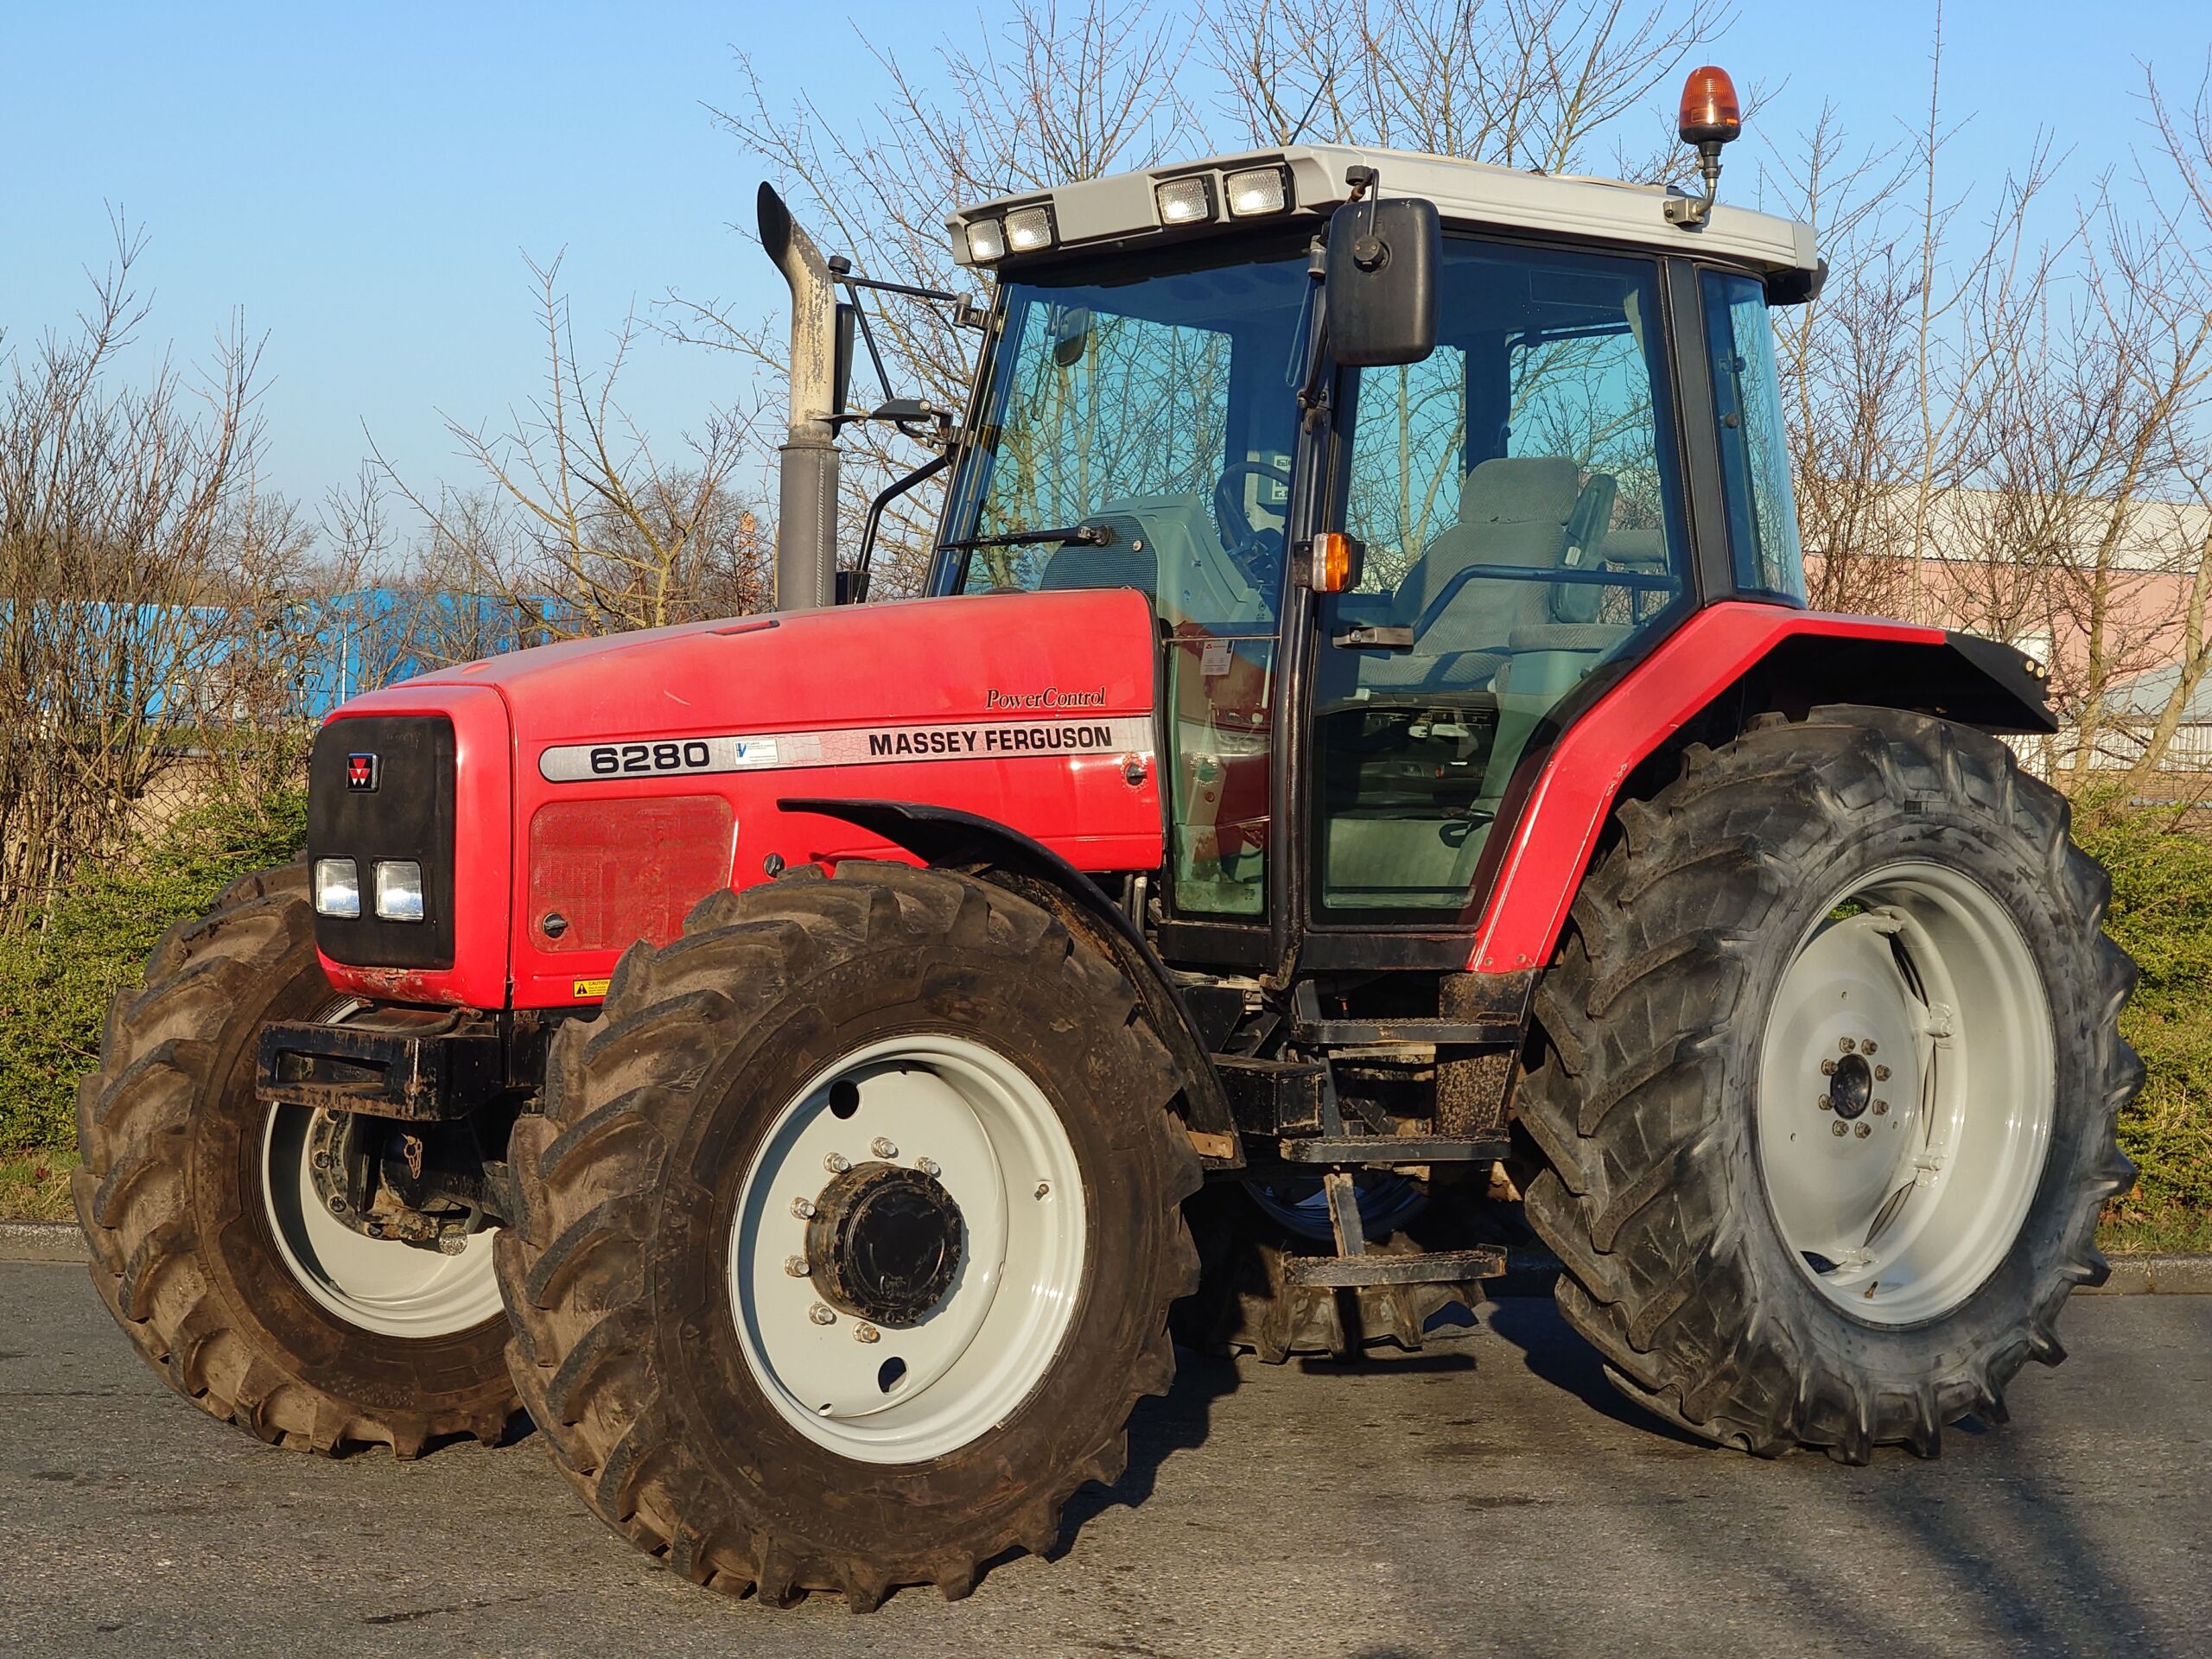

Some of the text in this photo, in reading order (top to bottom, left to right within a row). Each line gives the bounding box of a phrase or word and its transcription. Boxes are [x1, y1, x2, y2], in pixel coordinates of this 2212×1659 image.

[985, 686, 1106, 709] PowerControl
[868, 726, 1112, 756] MASSEY FERGUSON
[590, 741, 710, 774] 6280
